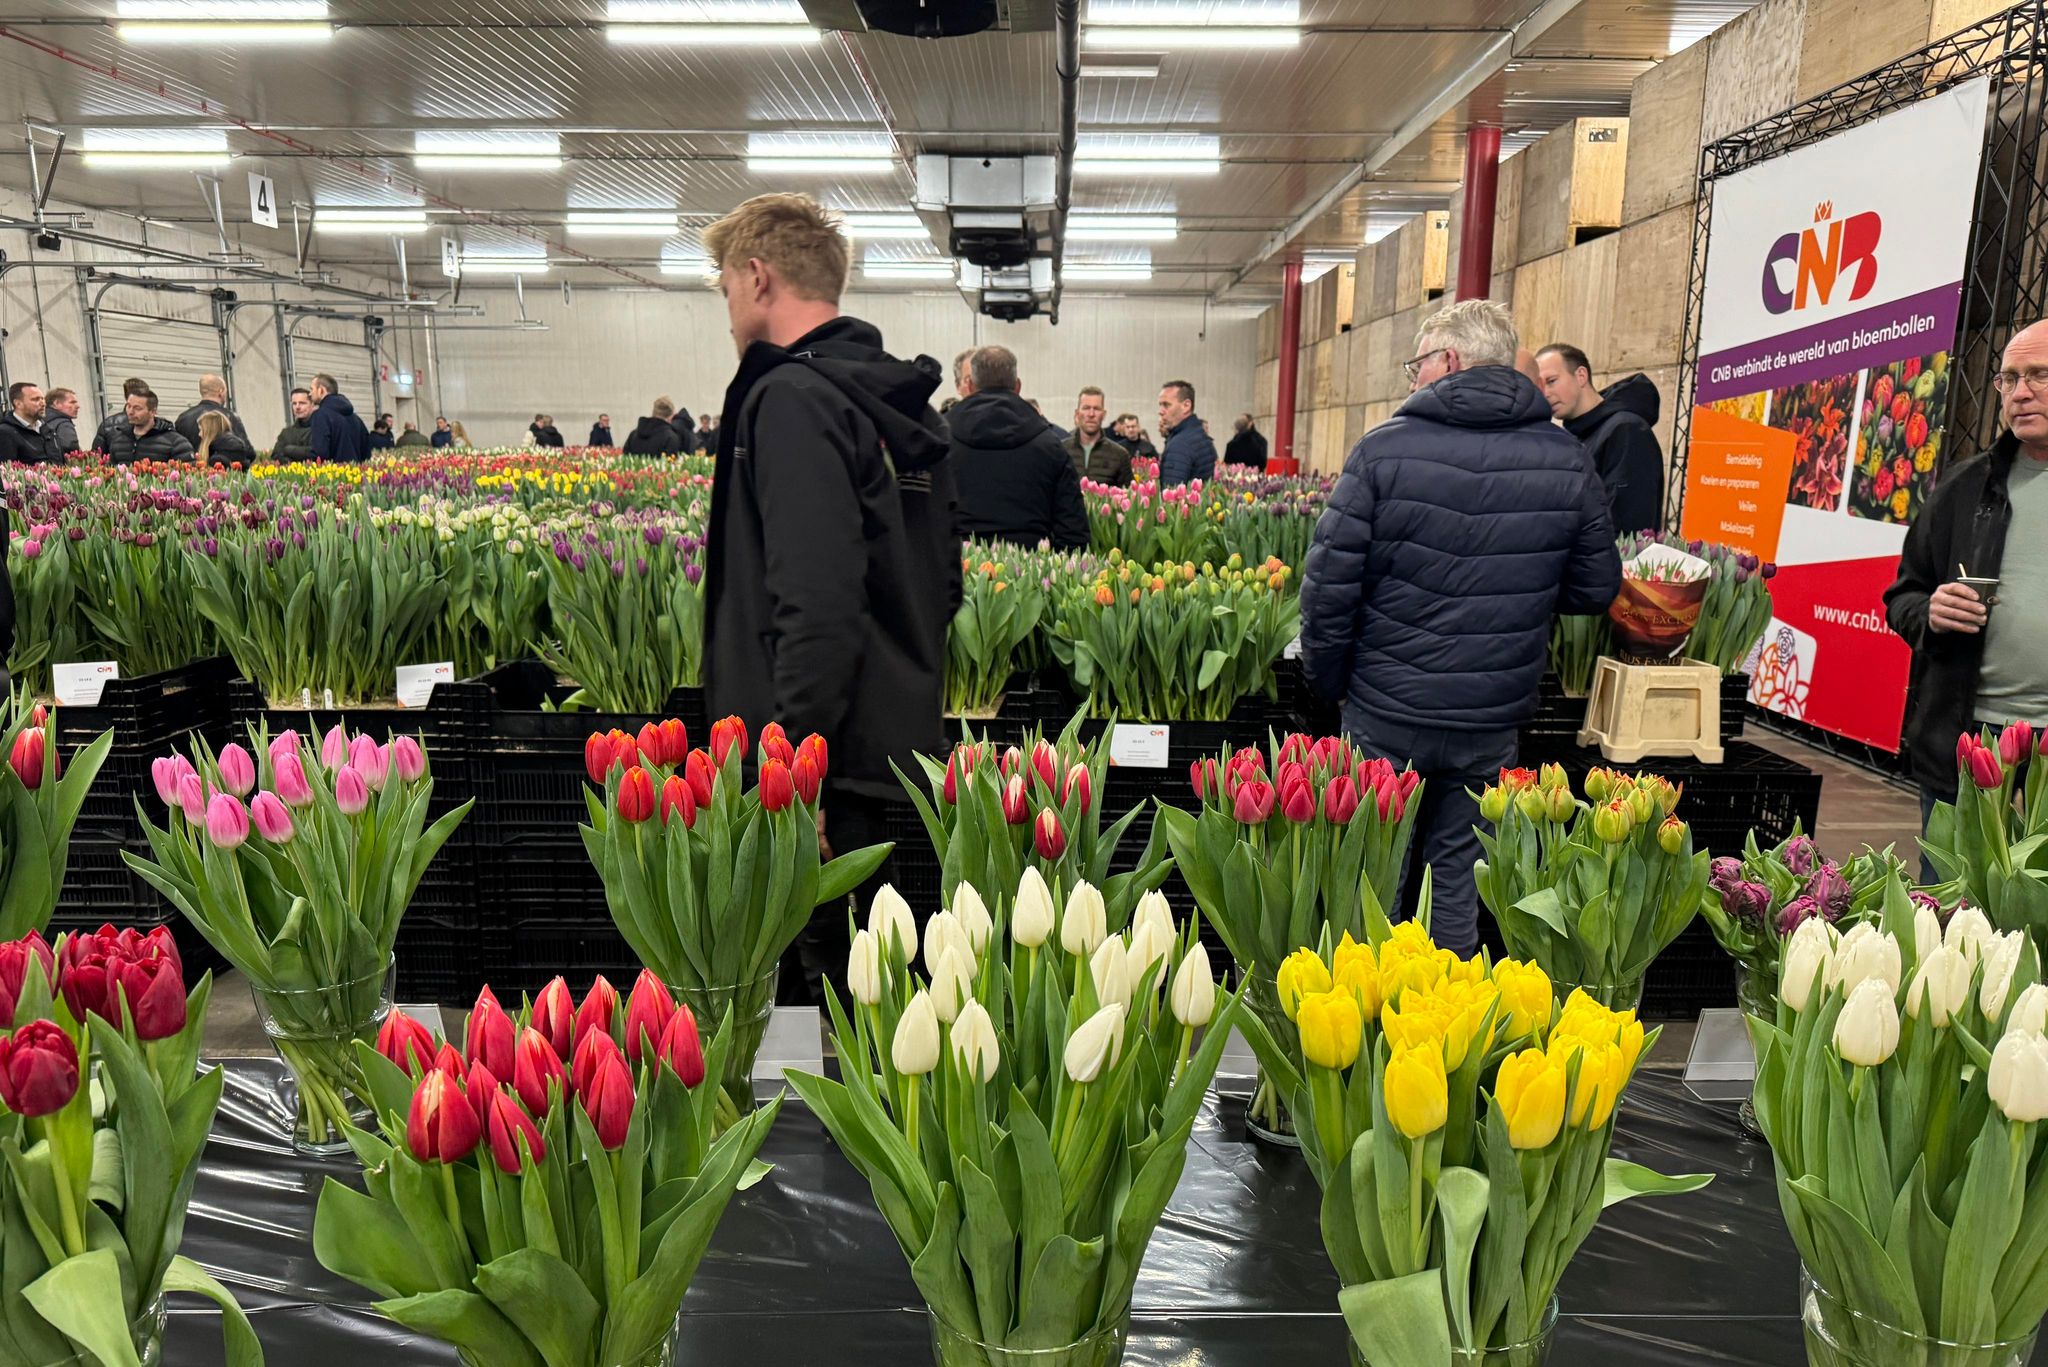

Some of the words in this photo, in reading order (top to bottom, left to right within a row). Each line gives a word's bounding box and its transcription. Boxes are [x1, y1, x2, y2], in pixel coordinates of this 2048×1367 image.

[257, 180, 270, 214] 4
[1762, 210, 1882, 315] CNB
[1711, 364, 1732, 384] CNB
[1732, 355, 1773, 379] verbindt
[1773, 351, 1787, 369] de
[1788, 340, 1825, 366] wereld
[1827, 337, 1850, 357] van
[1852, 315, 1935, 350] bloembollen
